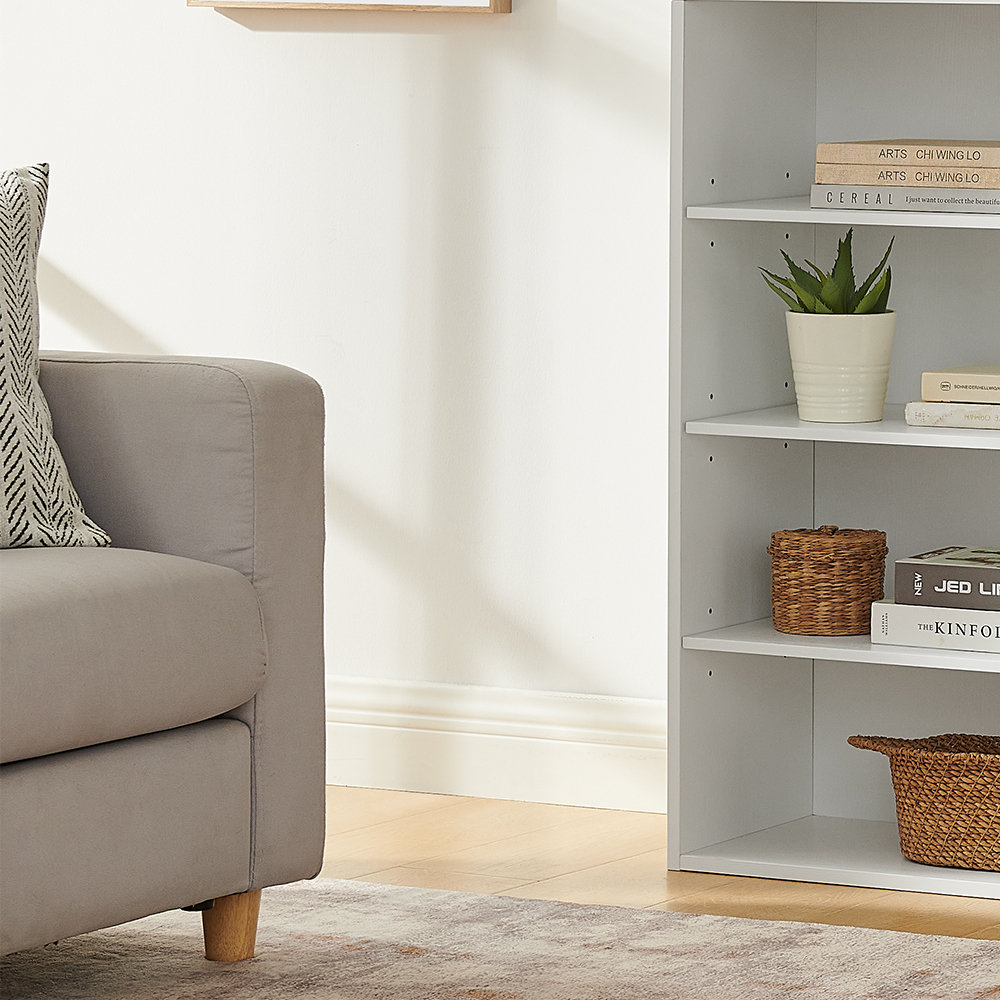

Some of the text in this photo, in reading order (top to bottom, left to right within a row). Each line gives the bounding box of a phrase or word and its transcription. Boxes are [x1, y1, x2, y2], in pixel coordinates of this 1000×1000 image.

[878, 149, 981, 161] ARTS CHI WING LO
[877, 171, 980, 184] ARTS CHI WING LO
[826, 192, 894, 205] CEREAL
[908, 196, 921, 204] just
[964, 197, 975, 205] the
[914, 572, 923, 596] NEW
[934, 580, 972, 594] JED
[917, 623, 934, 631] THE
